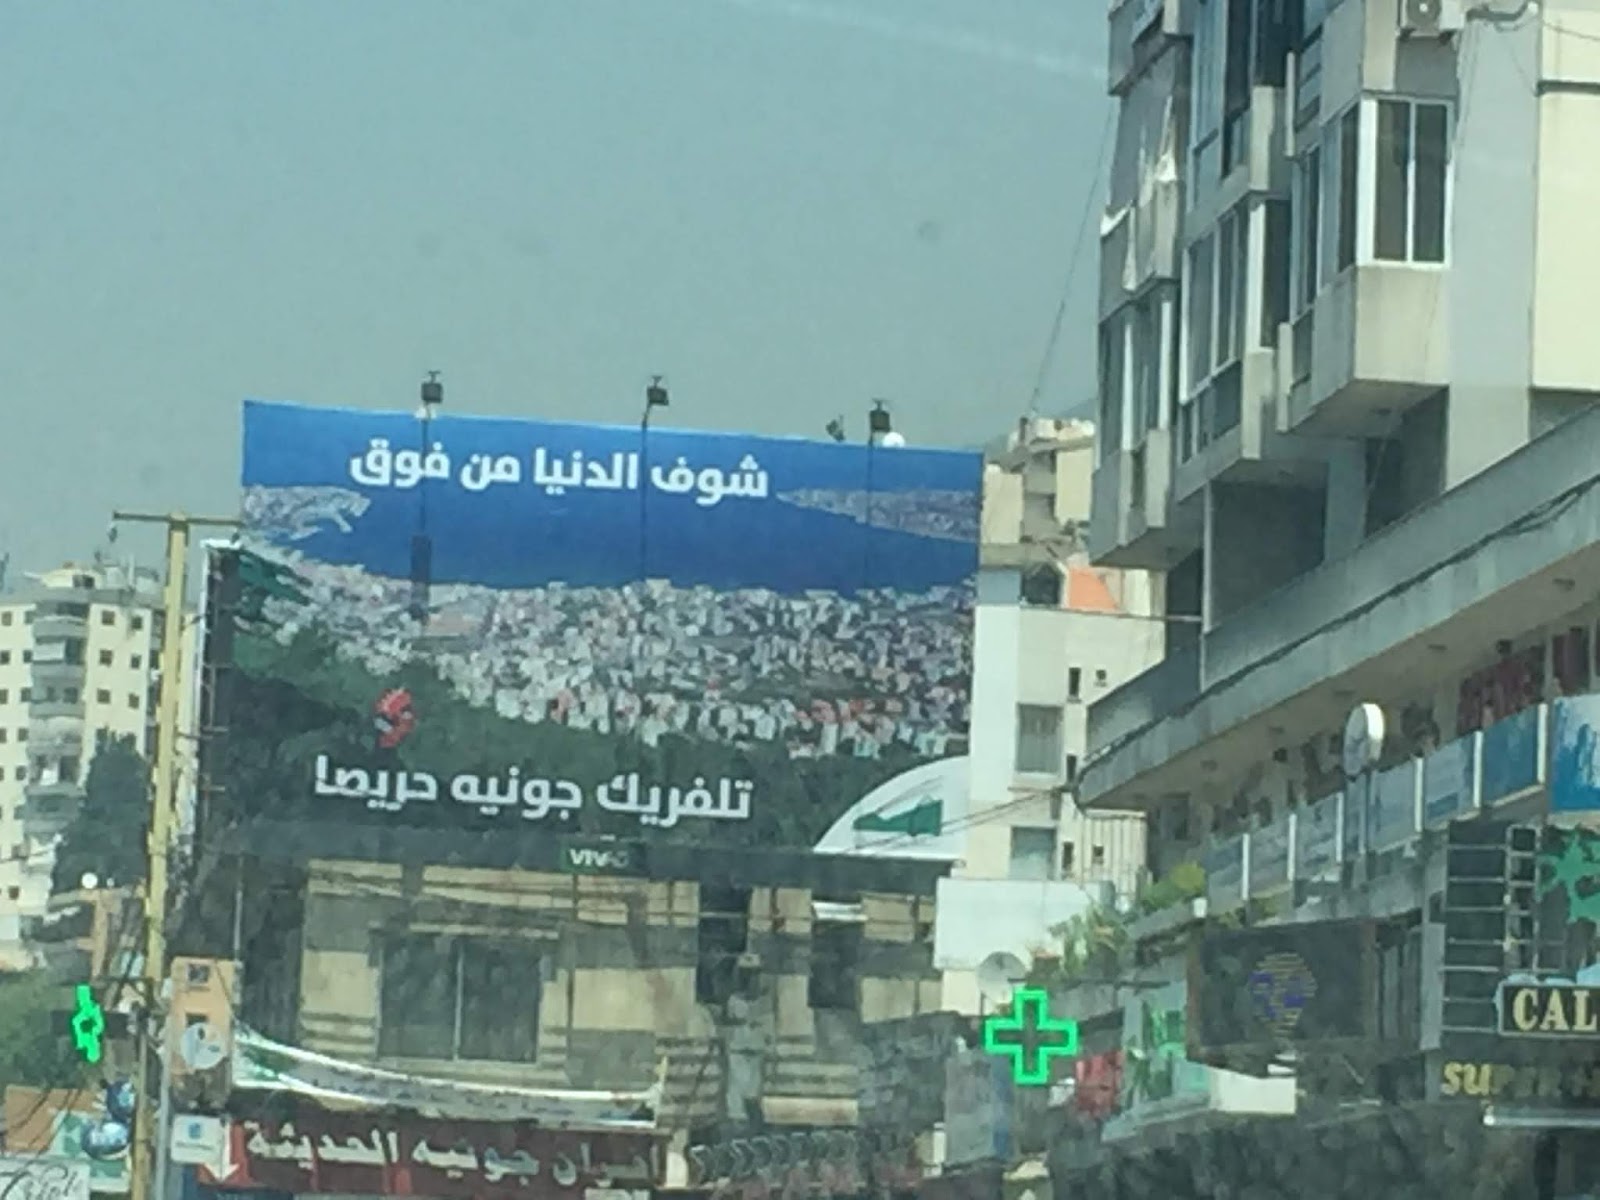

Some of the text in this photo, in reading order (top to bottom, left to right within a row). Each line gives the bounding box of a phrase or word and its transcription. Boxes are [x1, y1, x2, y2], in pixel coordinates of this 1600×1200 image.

[350, 437, 769, 507] شوف الدنيا من فوق
[314, 754, 754, 828] تلفريك جونيه حريصا
[1512, 986, 1598, 1032] CAL
